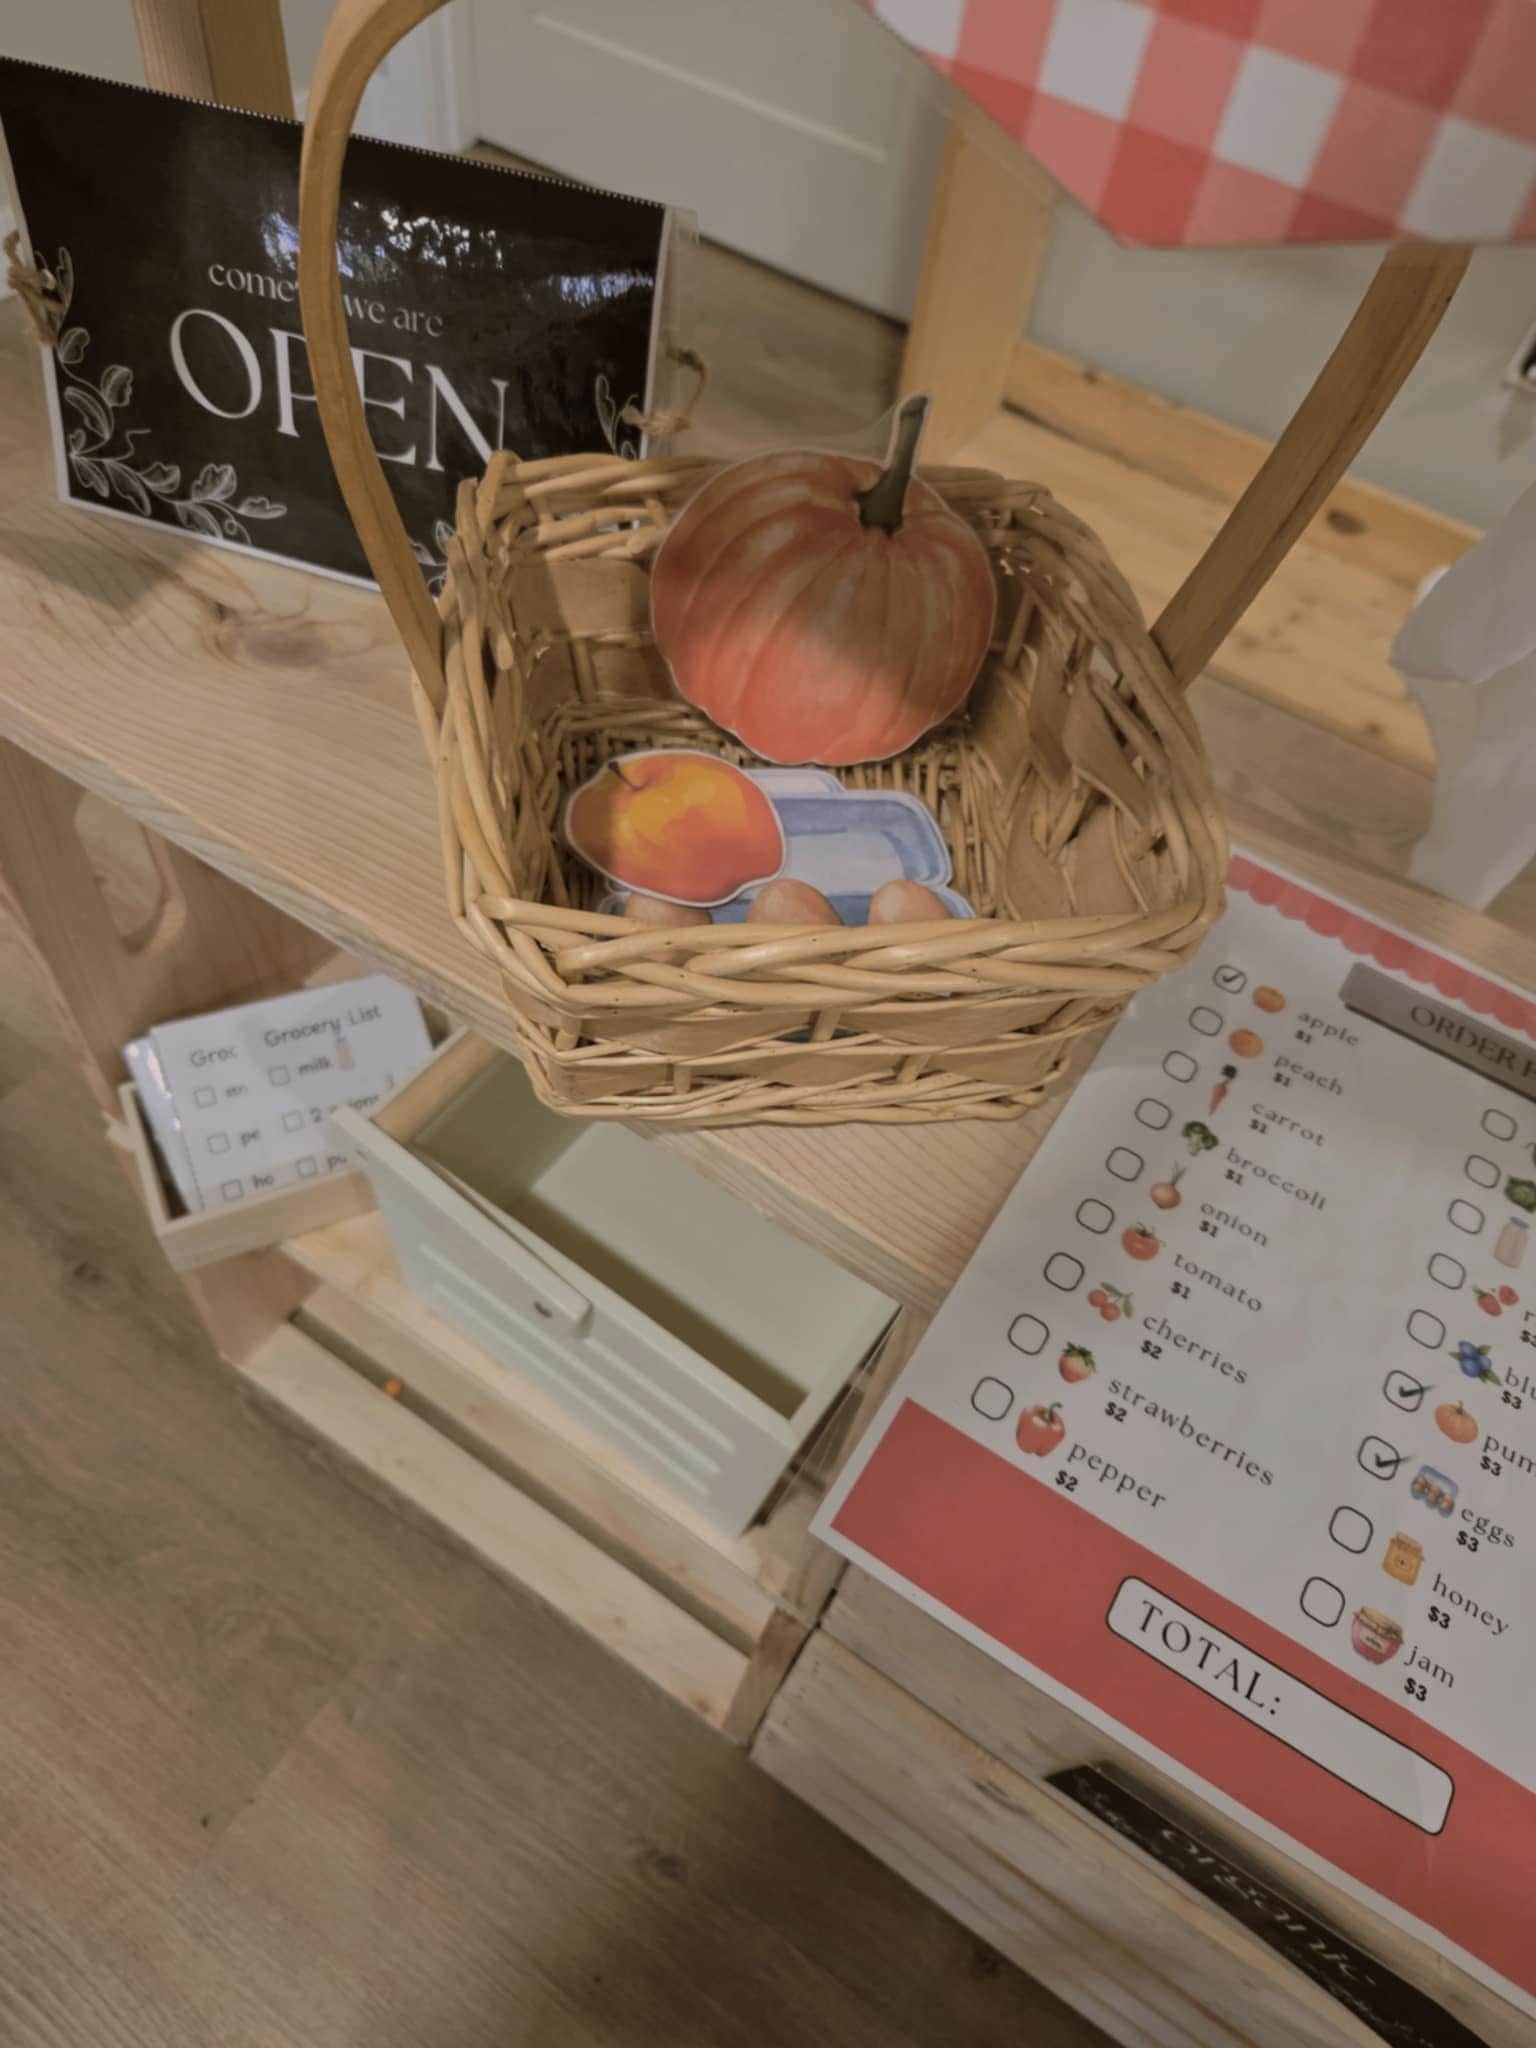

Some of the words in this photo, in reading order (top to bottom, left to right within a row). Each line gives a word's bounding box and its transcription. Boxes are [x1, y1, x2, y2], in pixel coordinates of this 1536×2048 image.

[208, 264, 296, 302] come
[343, 294, 386, 324] we
[393, 307, 444, 338] are
[170, 308, 509, 472] OPEN
[263, 1017, 342, 1047] Grocery
[348, 1004, 382, 1026] List
[1294, 1029, 1313, 1045] $1
[1298, 1012, 1360, 1047] apple
[1410, 1005, 1518, 1072] ORDER
[297, 1056, 332, 1075] milk
[1273, 1055, 1343, 1096] peach
[1273, 1071, 1292, 1088] $1
[1249, 1118, 1268, 1135] $1
[1252, 1102, 1325, 1147] carrot
[1224, 1168, 1244, 1186] $1
[1226, 1147, 1328, 1212] broccoli
[1199, 1220, 1219, 1238] $1
[1200, 1202, 1269, 1247] onion
[1171, 1281, 1191, 1300] $1
[1174, 1253, 1263, 1312] tomato
[1140, 1339, 1163, 1360] $2
[1143, 1315, 1249, 1385] cherries
[1104, 1401, 1128, 1423] $2
[1500, 1389, 1523, 1410] $3
[1108, 1379, 1275, 1487] strawberries
[1055, 1469, 1079, 1492] $2
[1066, 1443, 1167, 1508] pepper
[1480, 1455, 1502, 1476] $3
[1456, 1530, 1479, 1552] $3
[1460, 1507, 1516, 1549] eggs
[1428, 1605, 1451, 1629] $3
[1432, 1573, 1510, 1636] honey
[1139, 1600, 1281, 1716] TOTAL:
[1403, 1645, 1455, 1689] jam
[1403, 1677, 1428, 1702] $3
